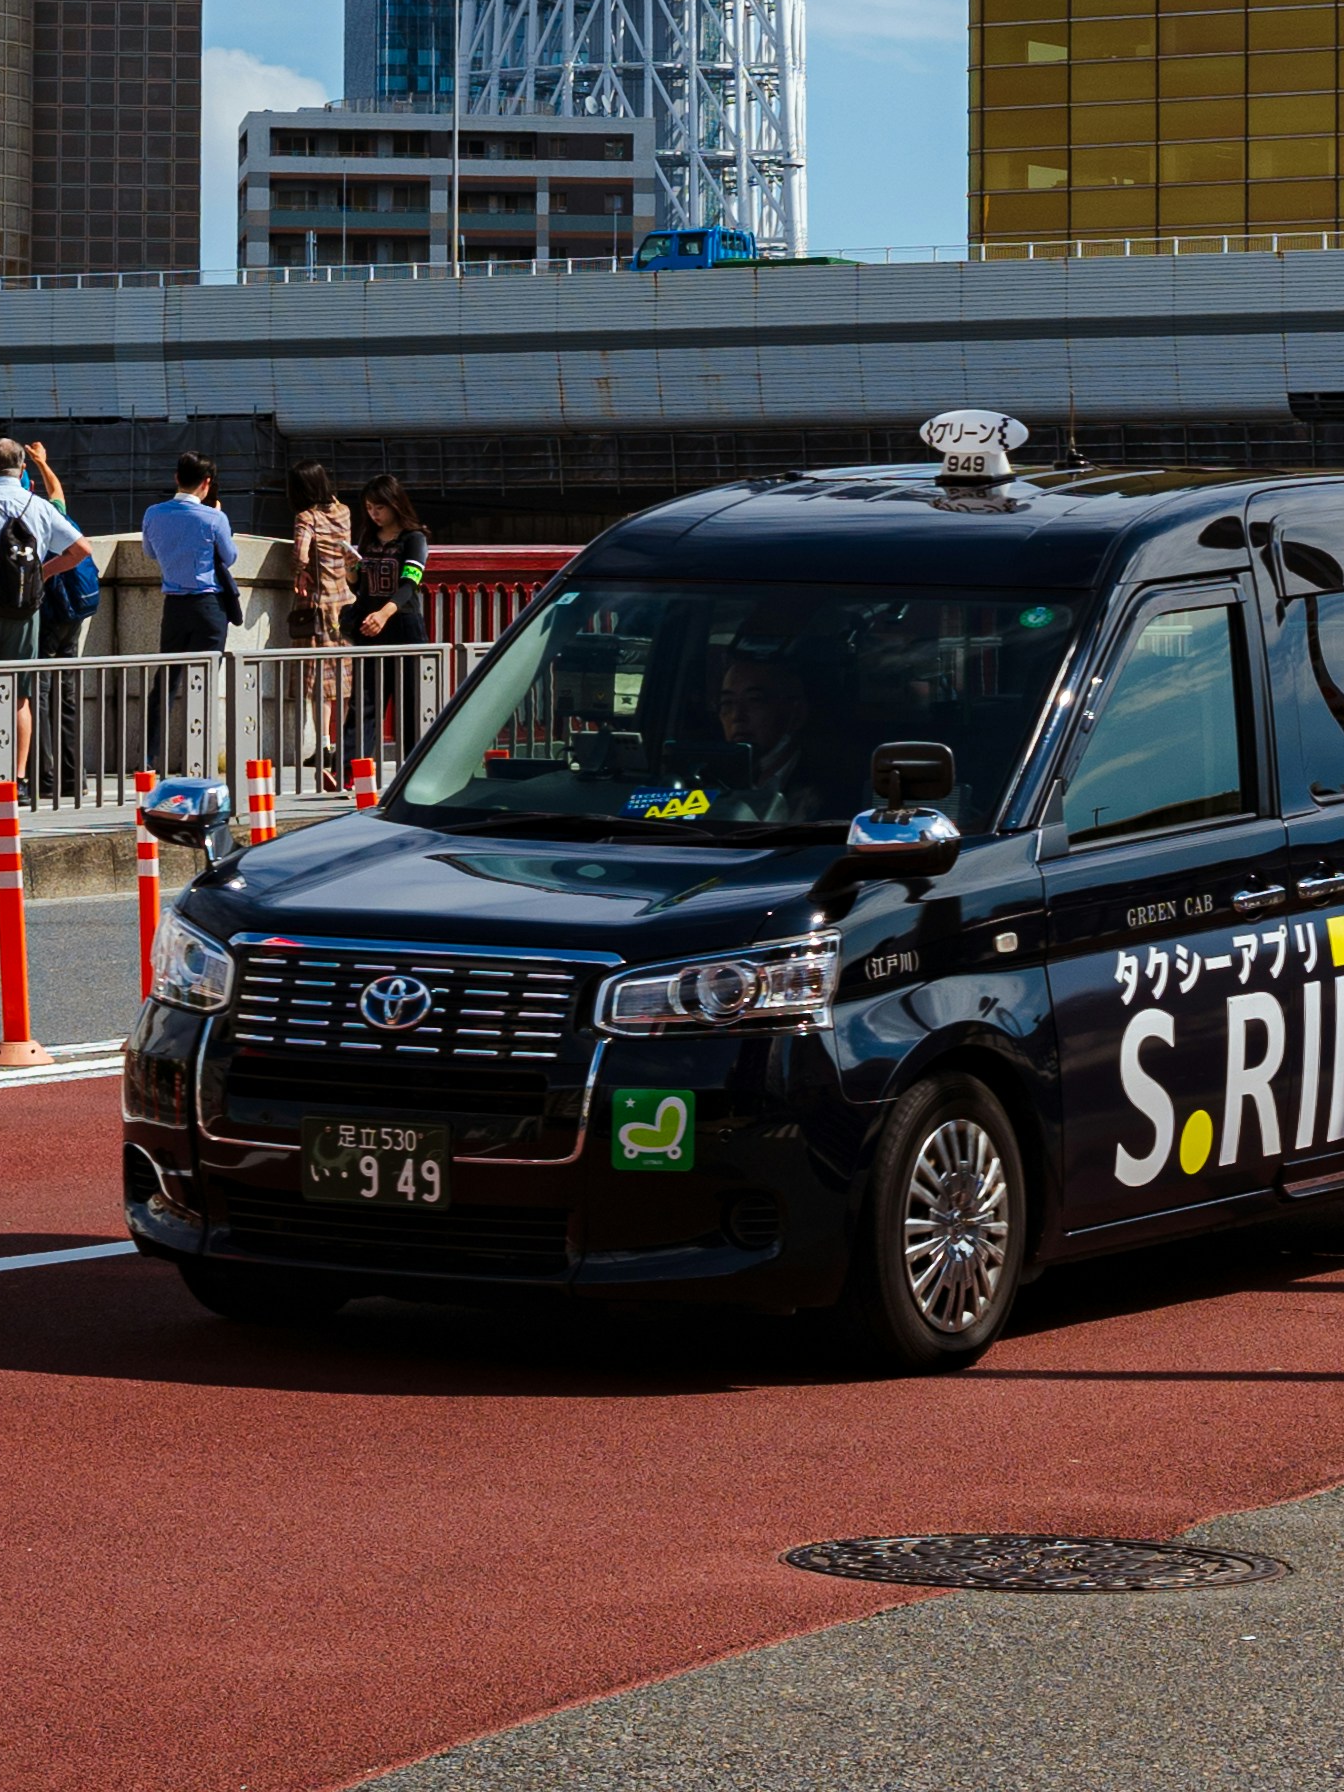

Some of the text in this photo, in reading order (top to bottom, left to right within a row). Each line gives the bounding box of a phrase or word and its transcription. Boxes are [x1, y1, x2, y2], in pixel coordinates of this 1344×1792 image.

[933, 421, 996, 444] グリーン
[947, 455, 985, 473] 949
[644, 789, 711, 819] AAA
[1127, 894, 1213, 927] GREEN CAB
[1113, 922, 1318, 1006] タクシーアプリ
